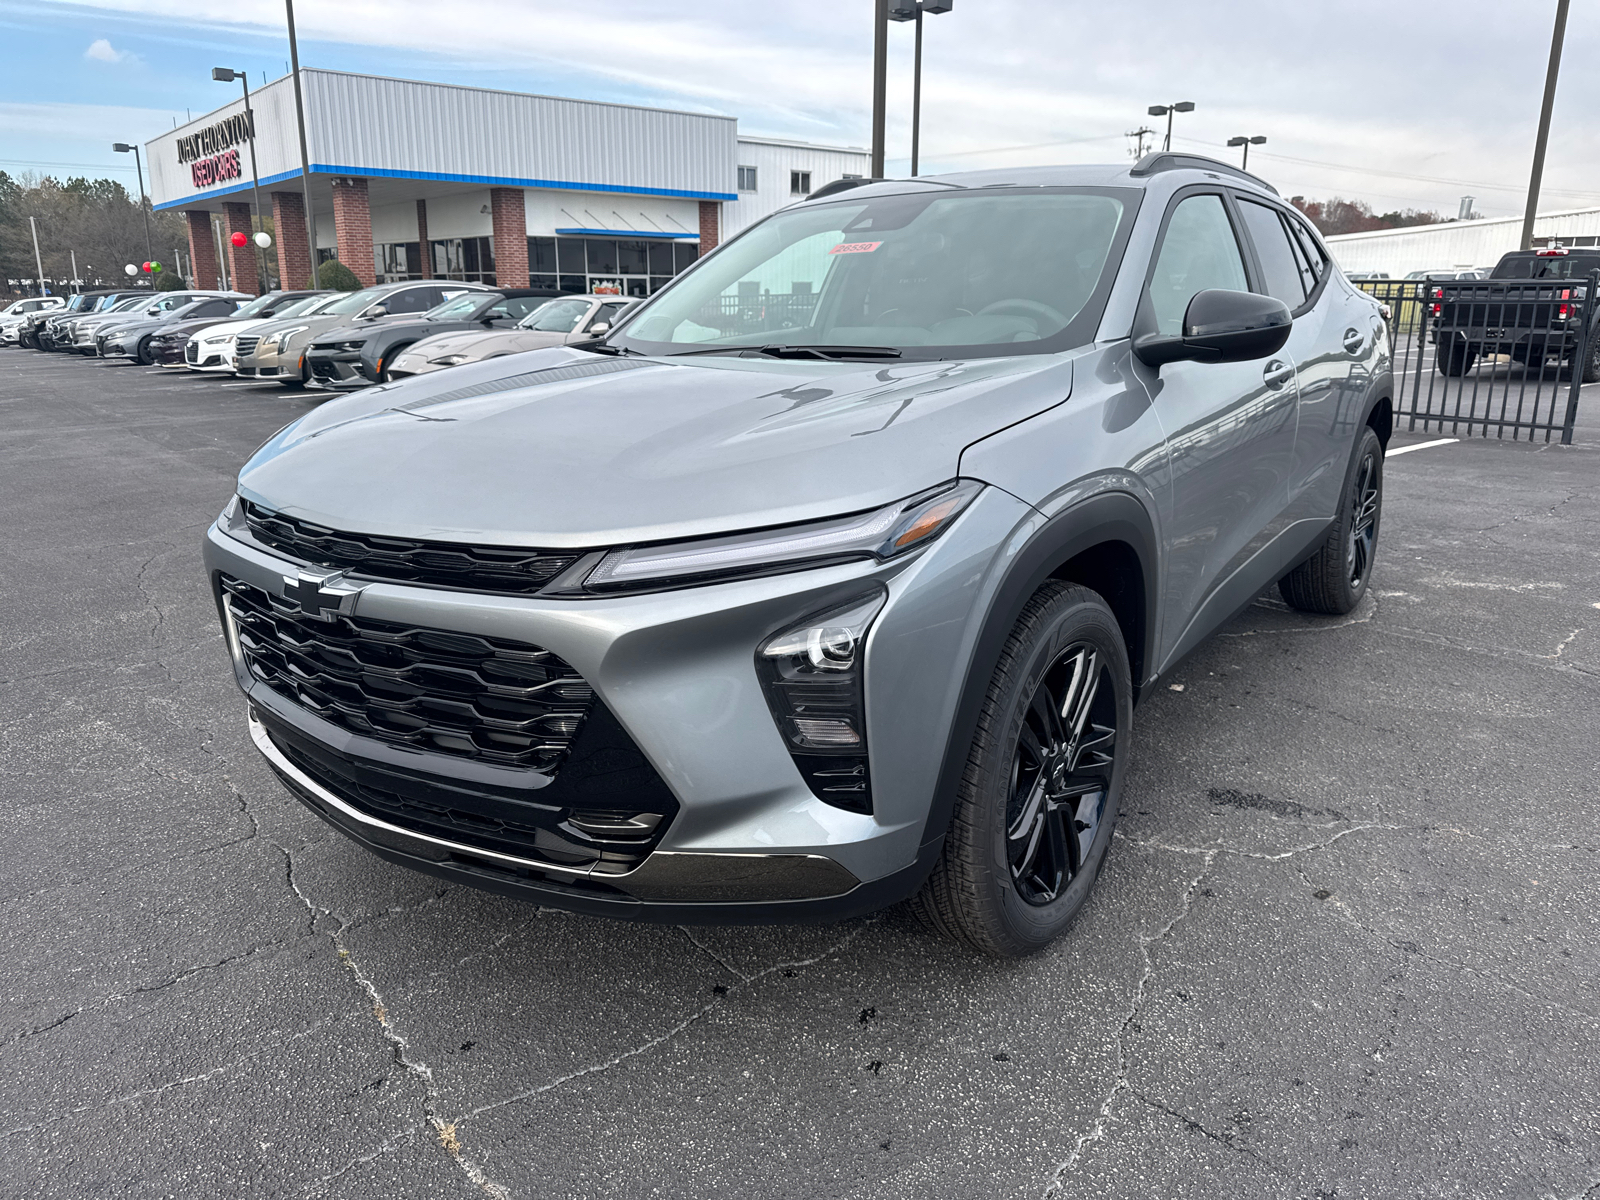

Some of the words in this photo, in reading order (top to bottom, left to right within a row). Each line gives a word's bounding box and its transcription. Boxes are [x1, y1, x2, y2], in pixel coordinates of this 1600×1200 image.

[176, 133, 200, 164] JOHN
[198, 109, 255, 156] THORNTON
[191, 159, 215, 188] USED
[213, 149, 241, 182] CARS
[835, 243, 873, 253] 26550
